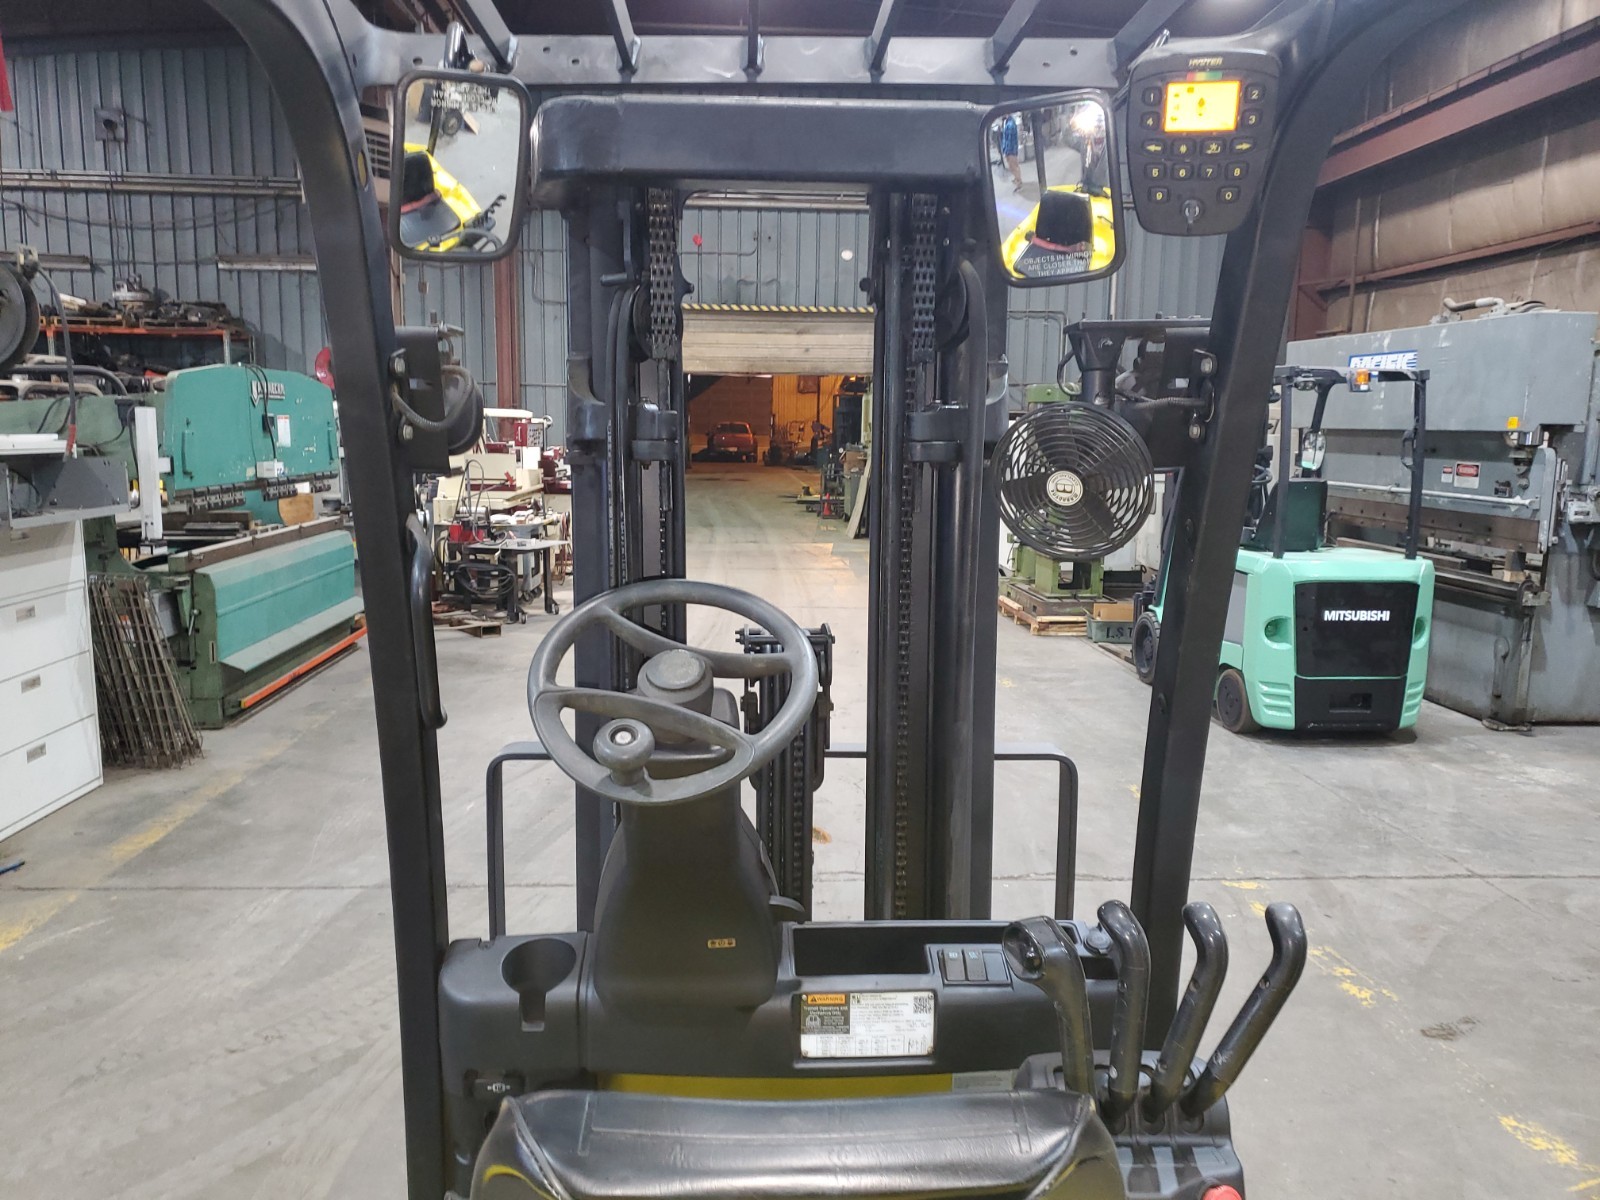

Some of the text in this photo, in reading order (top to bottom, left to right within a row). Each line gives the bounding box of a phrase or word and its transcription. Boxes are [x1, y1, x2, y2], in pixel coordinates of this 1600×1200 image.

[1024, 255, 1055, 264] OBJECTS
[1043, 260, 1072, 270] CLOSER
[1037, 269, 1054, 277] THEY
[1324, 610, 1390, 621] MITSUBISHI
